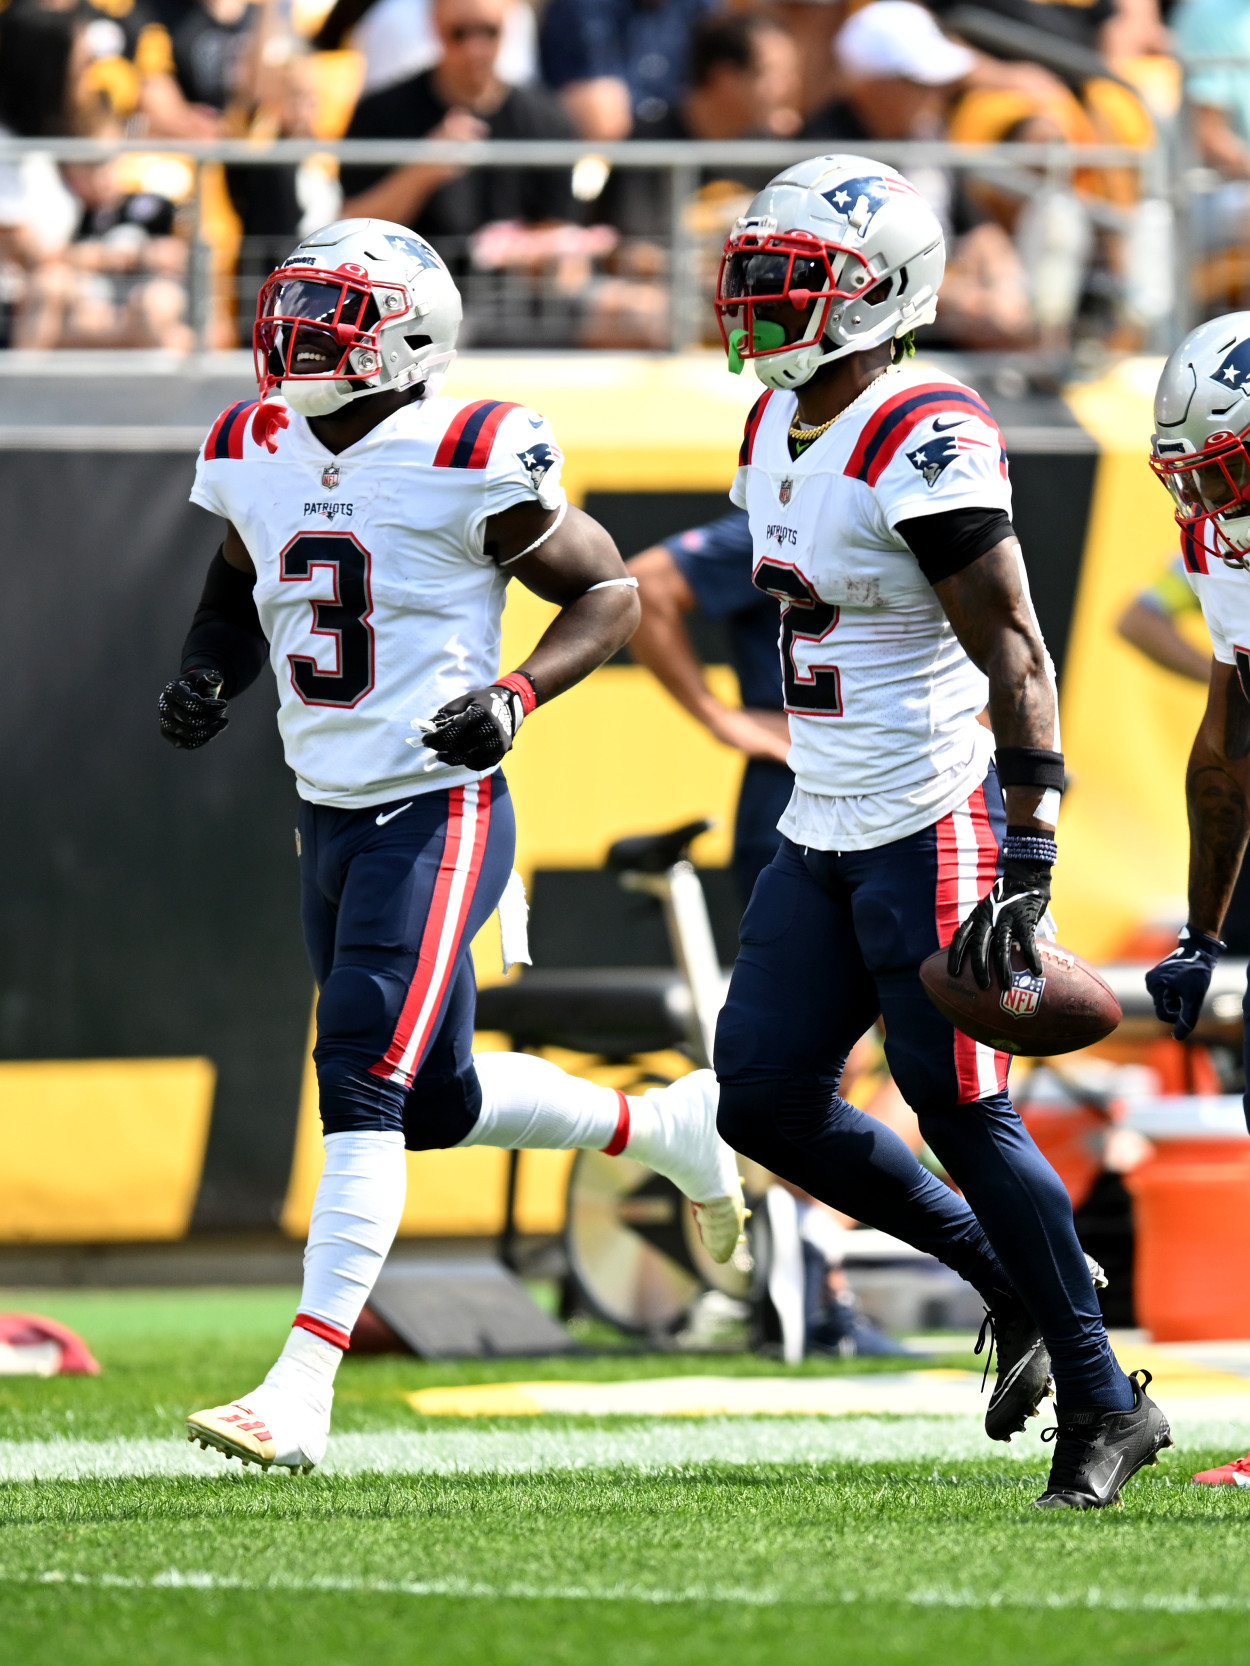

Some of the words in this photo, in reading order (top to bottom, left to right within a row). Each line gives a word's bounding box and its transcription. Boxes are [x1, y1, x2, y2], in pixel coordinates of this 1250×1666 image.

[303, 502, 354, 517] PATRIOTS
[766, 524, 798, 546] PATRIOTS
[279, 531, 375, 709] 3
[752, 555, 843, 717] 2
[1004, 989, 1035, 1013] NFL
